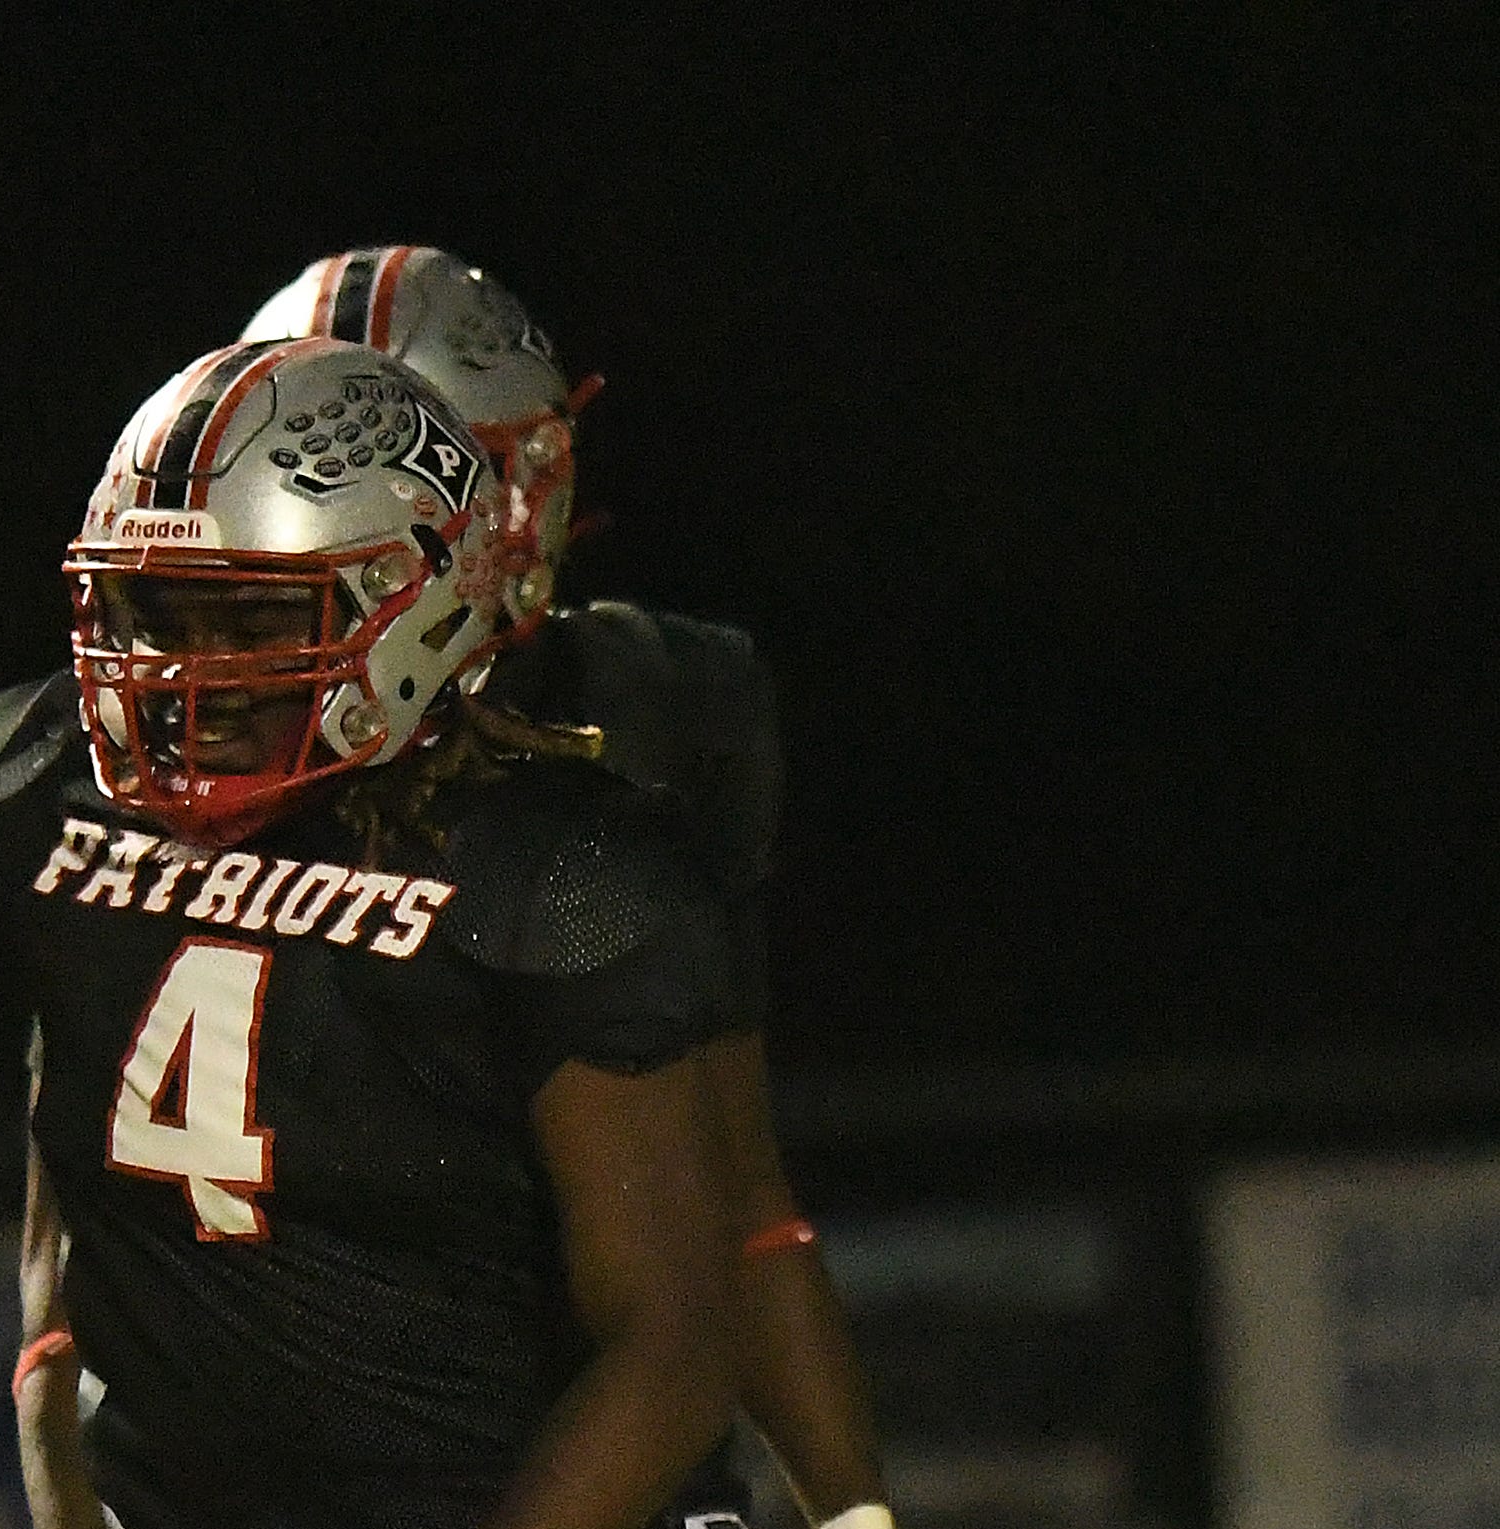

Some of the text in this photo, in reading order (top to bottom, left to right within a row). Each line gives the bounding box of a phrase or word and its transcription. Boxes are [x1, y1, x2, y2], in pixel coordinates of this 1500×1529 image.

[430, 444, 461, 477] P
[121, 519, 202, 539] Riddell
[32, 817, 457, 960] PATRIOTS
[105, 935, 276, 1243] 4
